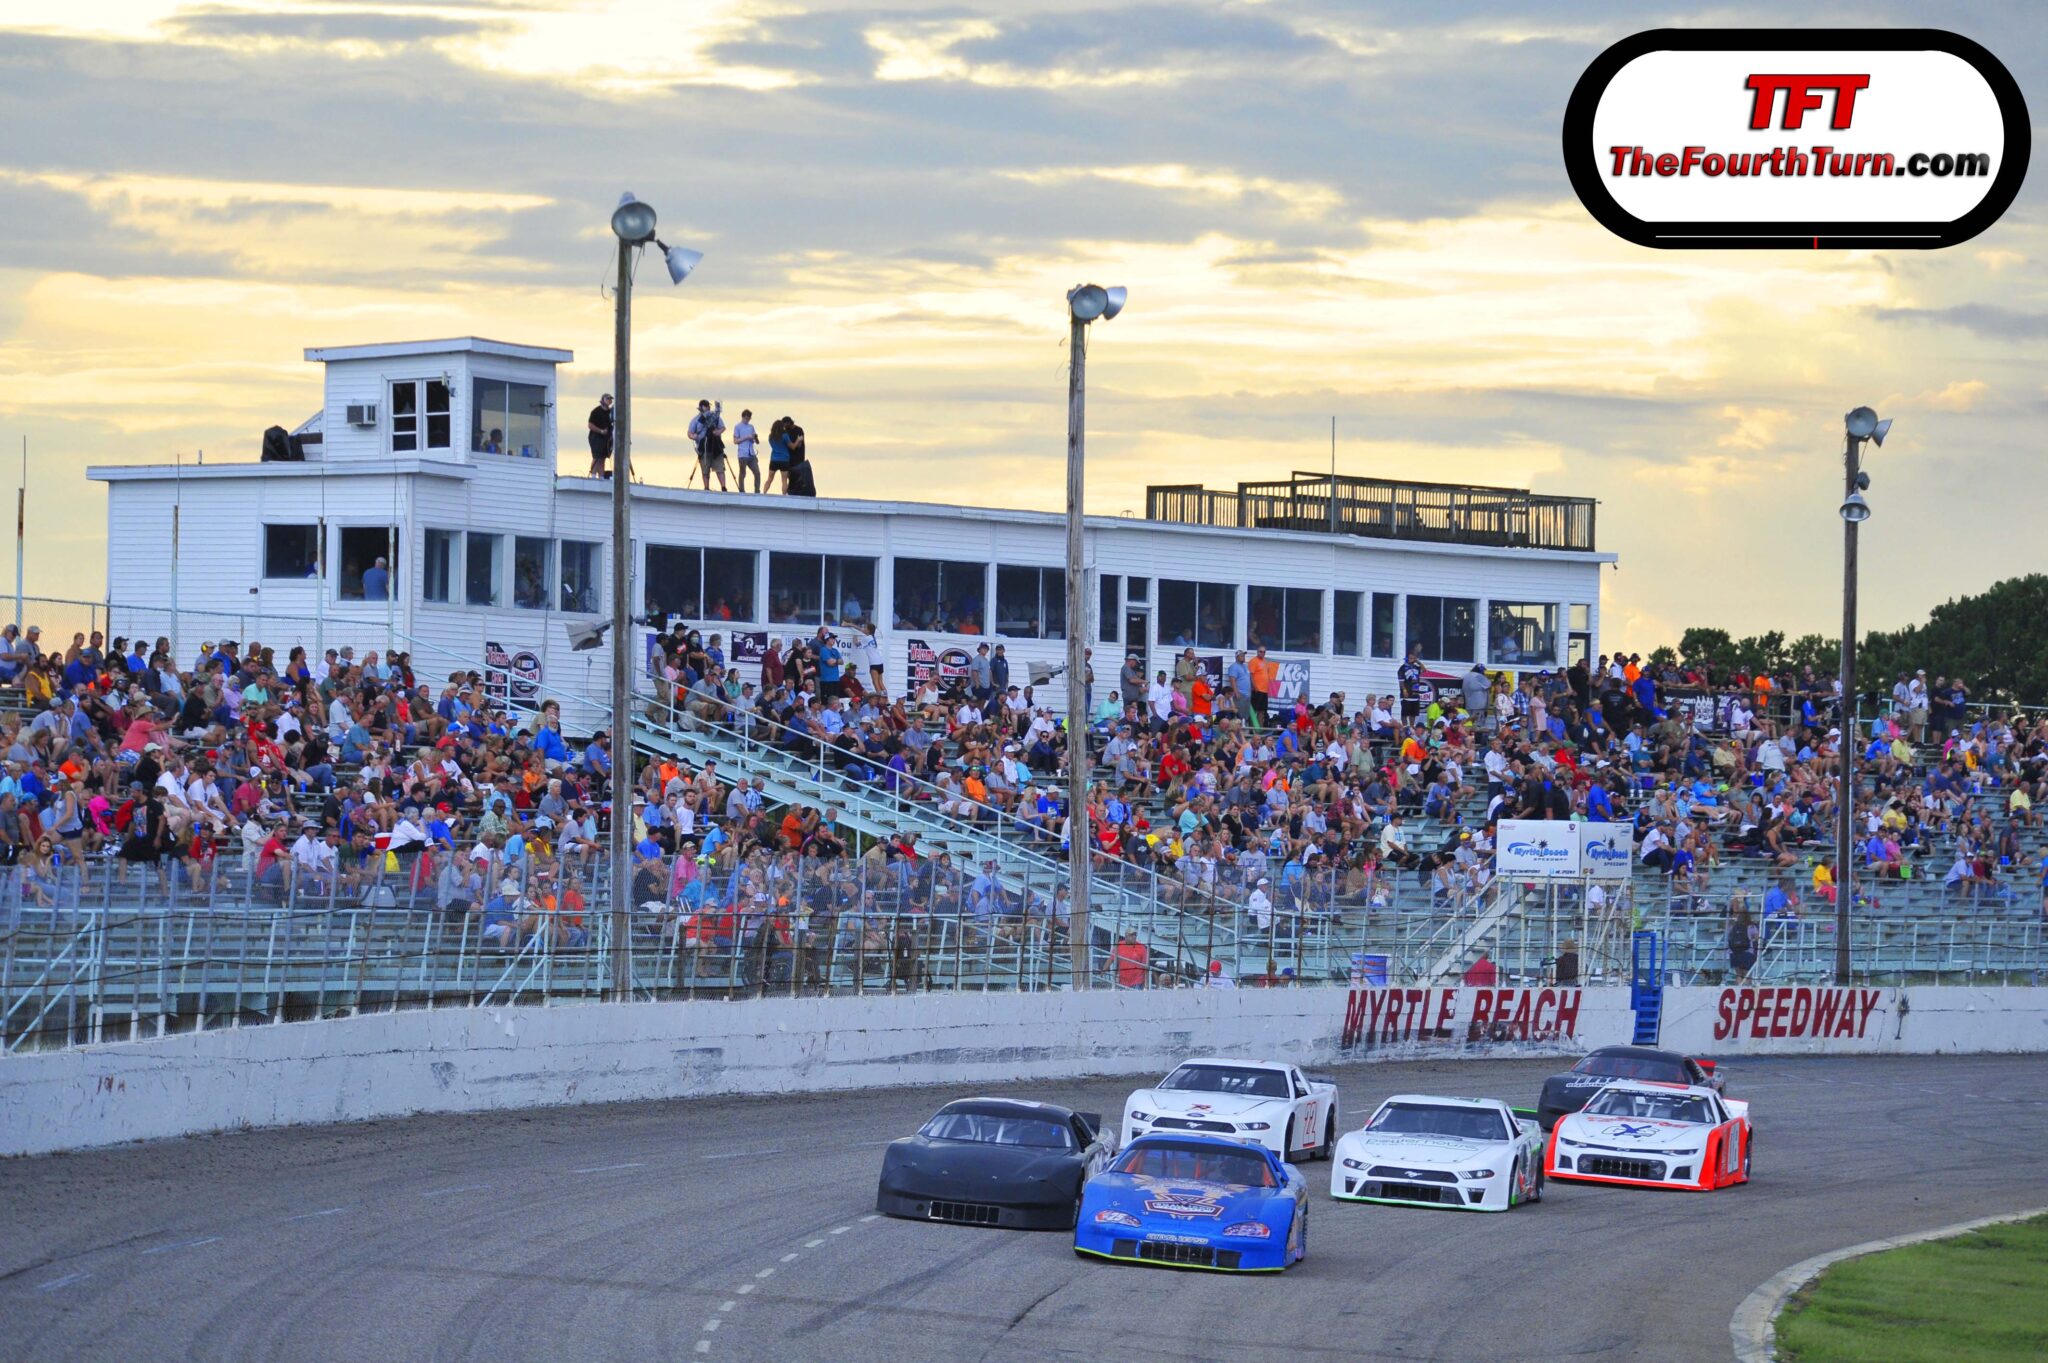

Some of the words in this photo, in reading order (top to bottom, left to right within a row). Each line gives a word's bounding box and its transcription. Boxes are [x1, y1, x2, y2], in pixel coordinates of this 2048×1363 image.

[836, 639, 852, 649] You
[1342, 988, 1458, 1050] MYRTLE
[1467, 989, 1583, 1043] BEACH
[1714, 988, 1880, 1041] SPEEDWAY
